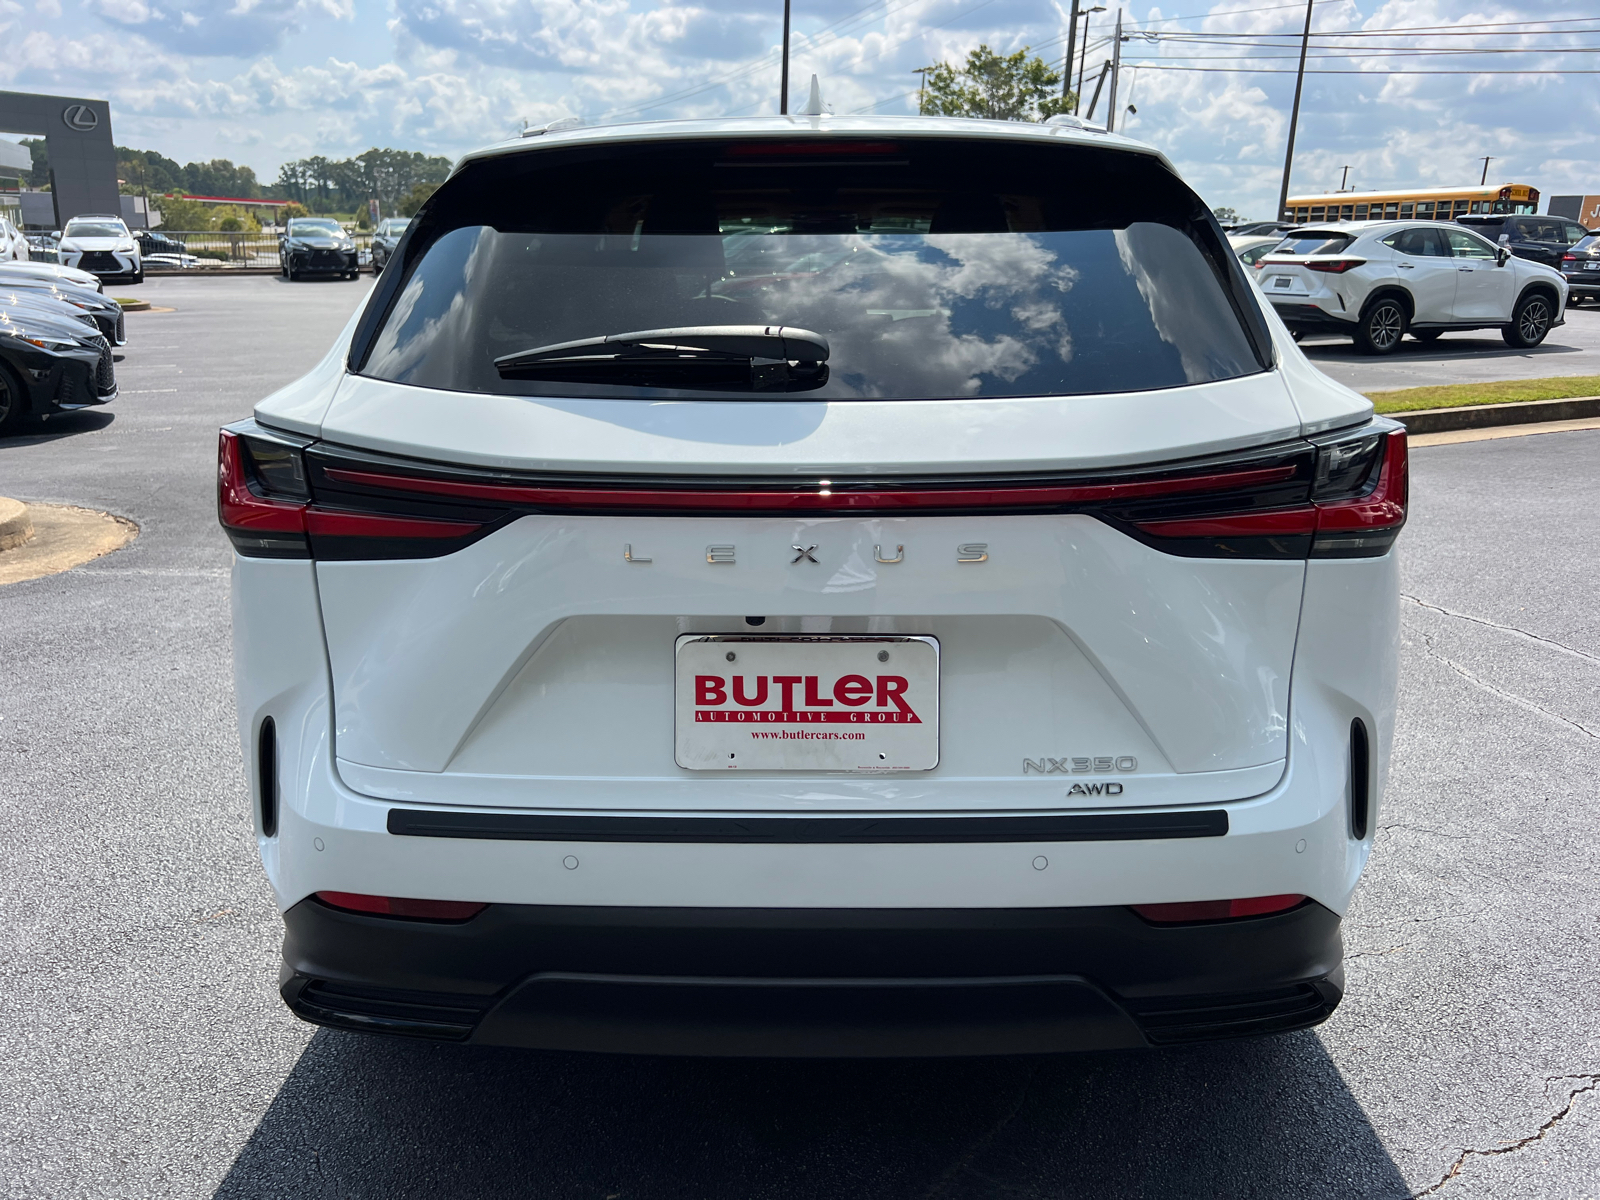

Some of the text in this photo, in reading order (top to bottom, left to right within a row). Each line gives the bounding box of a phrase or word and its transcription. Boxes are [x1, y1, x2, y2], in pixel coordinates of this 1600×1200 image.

[623, 543, 989, 564] LEXUS
[696, 712, 913, 722] AUTOMOTIVE GROUP
[751, 730, 866, 741] www.butlercars.com
[1067, 782, 1124, 797] AWD
